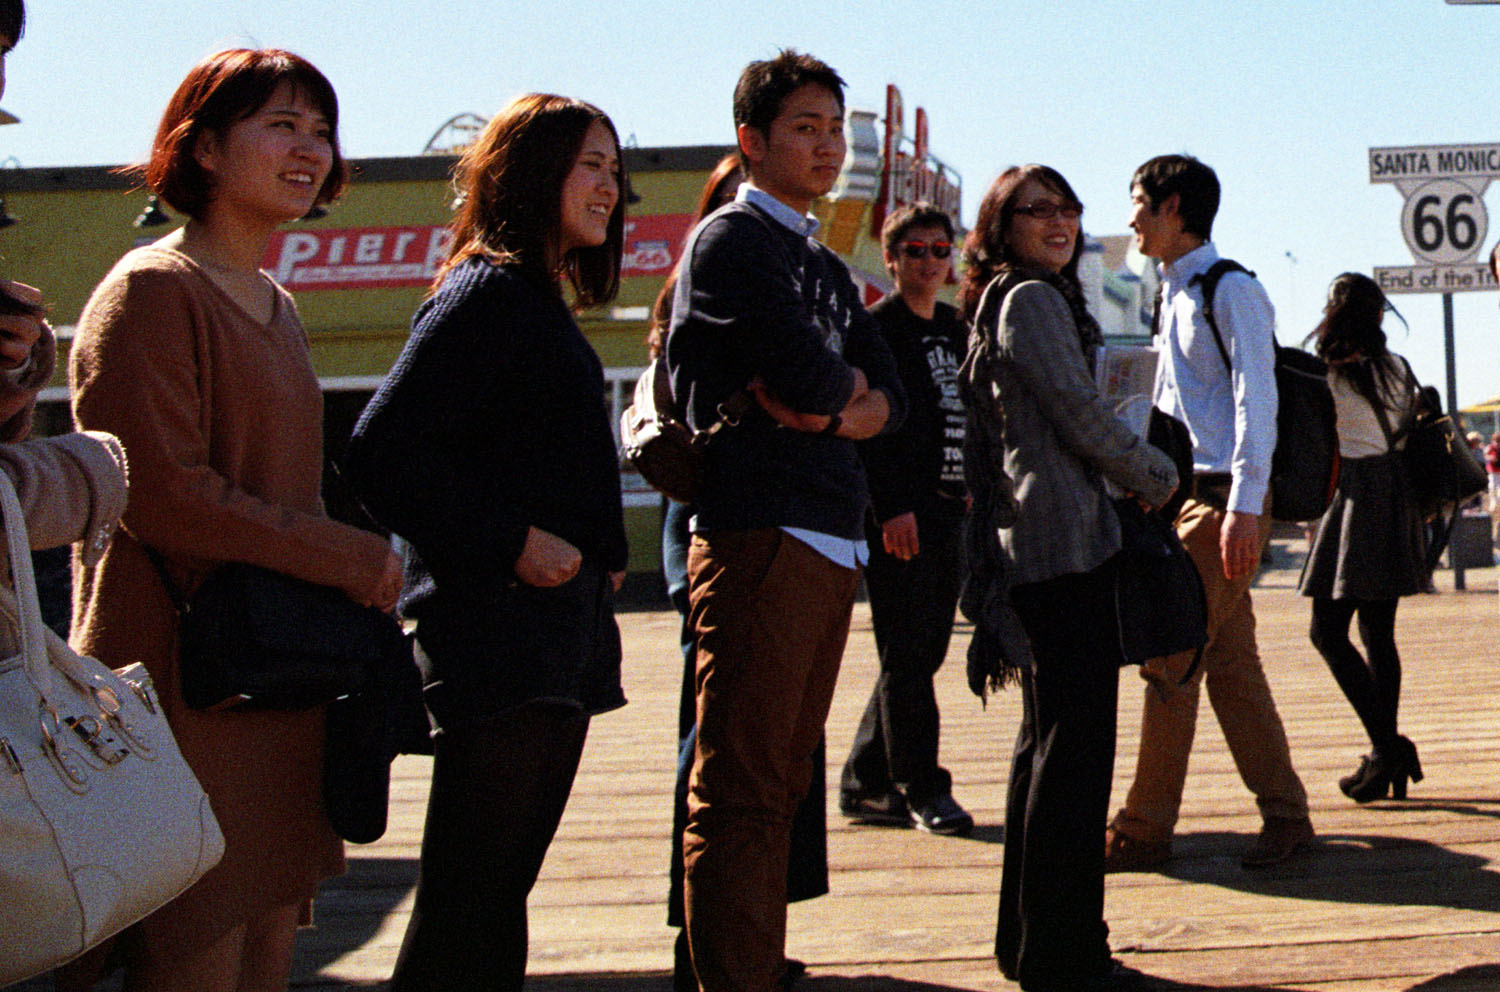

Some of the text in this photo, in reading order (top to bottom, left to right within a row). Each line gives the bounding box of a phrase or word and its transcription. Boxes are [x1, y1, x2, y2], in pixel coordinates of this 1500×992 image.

[1373, 152, 1431, 174] SANTA
[1413, 194, 1477, 252] 66
[1379, 271, 1413, 288] End
[1419, 268, 1438, 286] of
[1444, 269, 1473, 286] the
